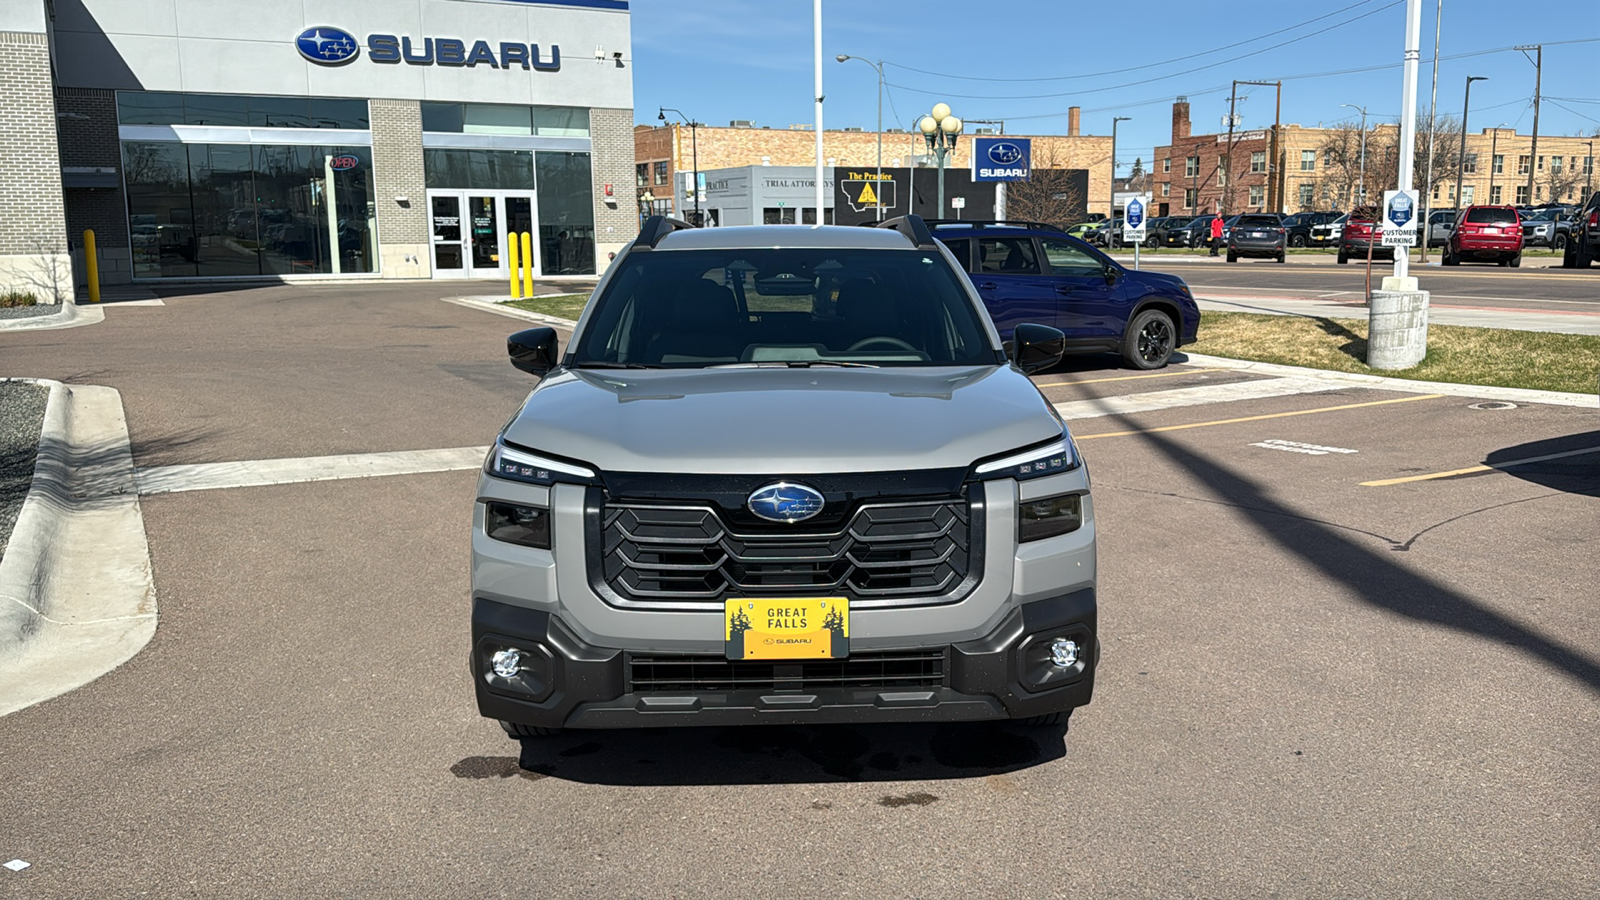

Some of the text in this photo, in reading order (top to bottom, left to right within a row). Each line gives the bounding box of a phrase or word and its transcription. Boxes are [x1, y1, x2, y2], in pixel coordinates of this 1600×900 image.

[368, 34, 560, 72] SUBARU
[330, 158, 355, 168] OPEN
[848, 172, 892, 180] The Pratice
[980, 168, 1027, 177] SUBARU
[706, 181, 729, 191] PRACTICE
[767, 608, 807, 617] GREAT
[767, 618, 807, 628] FALLS
